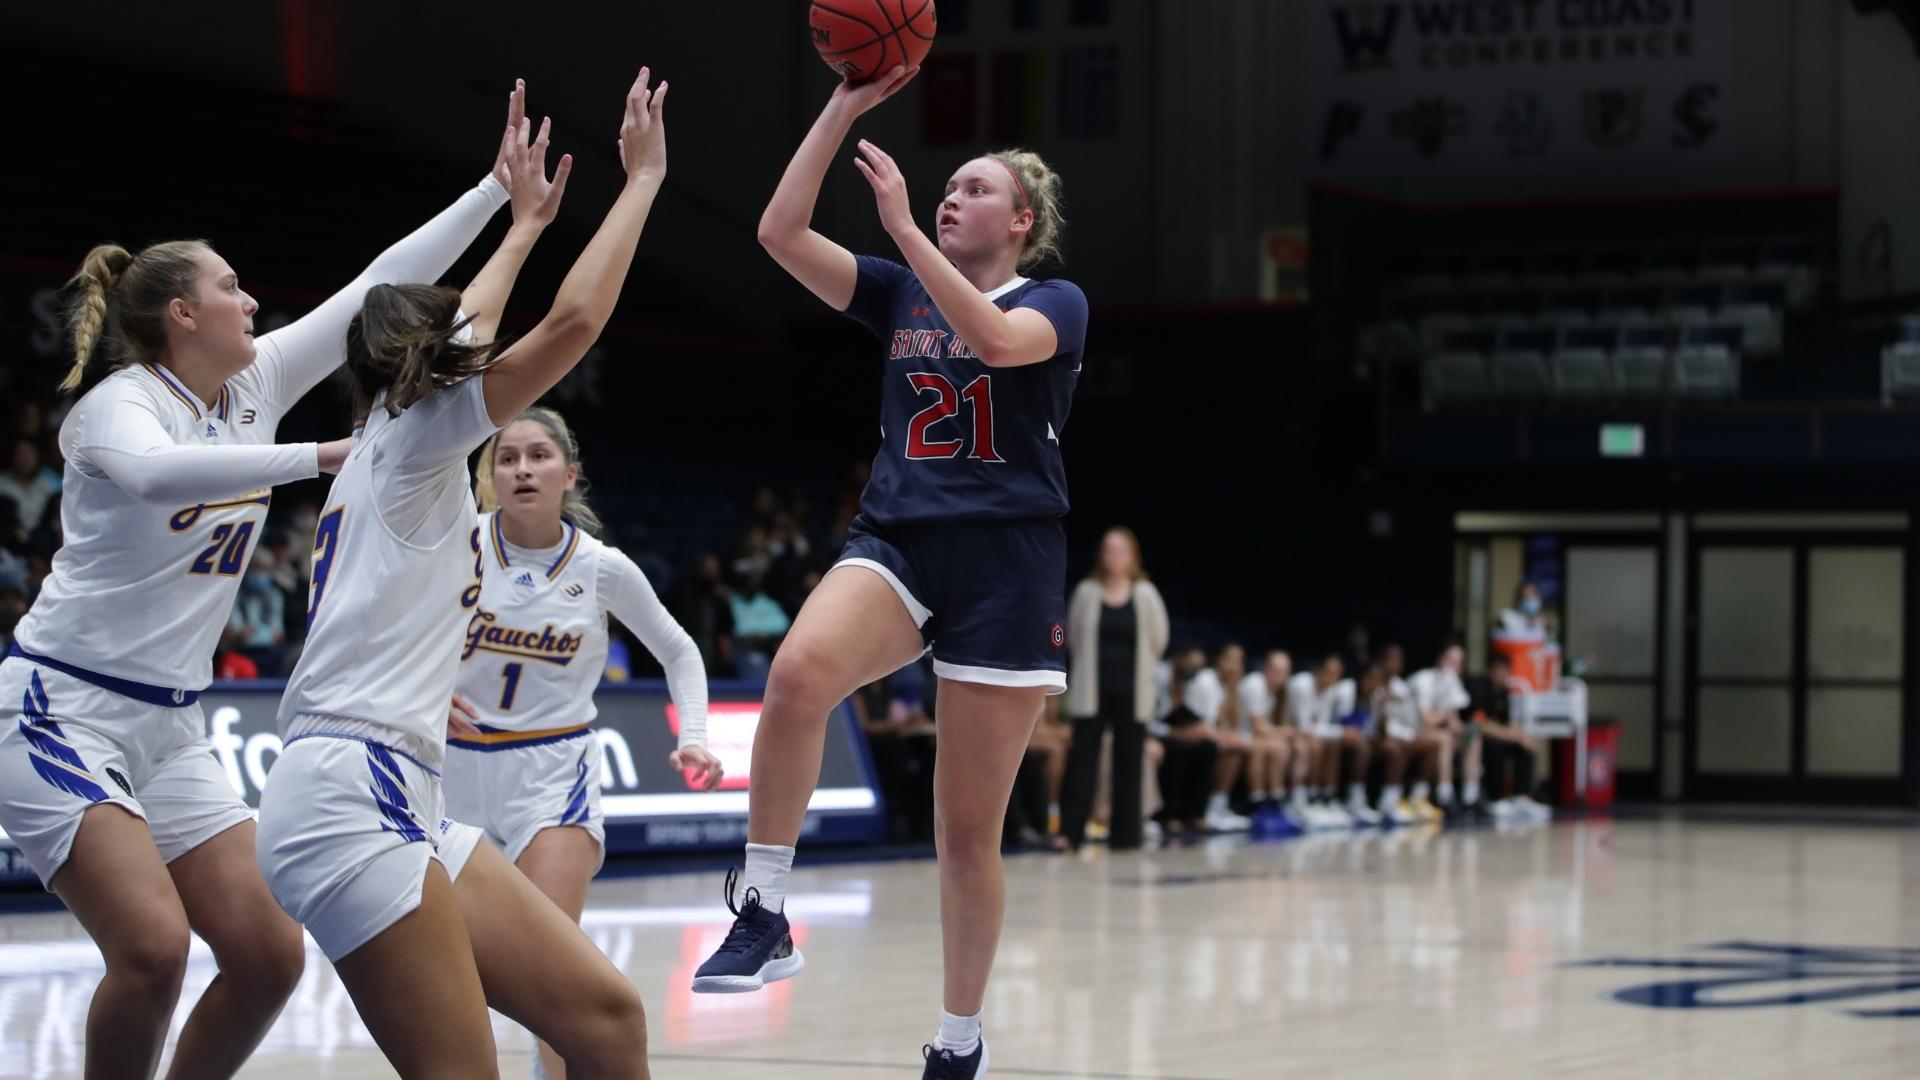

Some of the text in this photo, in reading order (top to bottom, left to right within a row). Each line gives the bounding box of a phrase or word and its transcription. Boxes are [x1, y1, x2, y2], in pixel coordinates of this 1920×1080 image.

[1413, 0, 1698, 35] WEST COAST
[1417, 30, 1694, 69] CONFERENCE
[889, 329, 949, 360] SAINT
[904, 371, 1008, 464] 21
[188, 521, 256, 577] 20
[461, 606, 584, 662] Gauchos
[499, 662, 523, 712] 1
